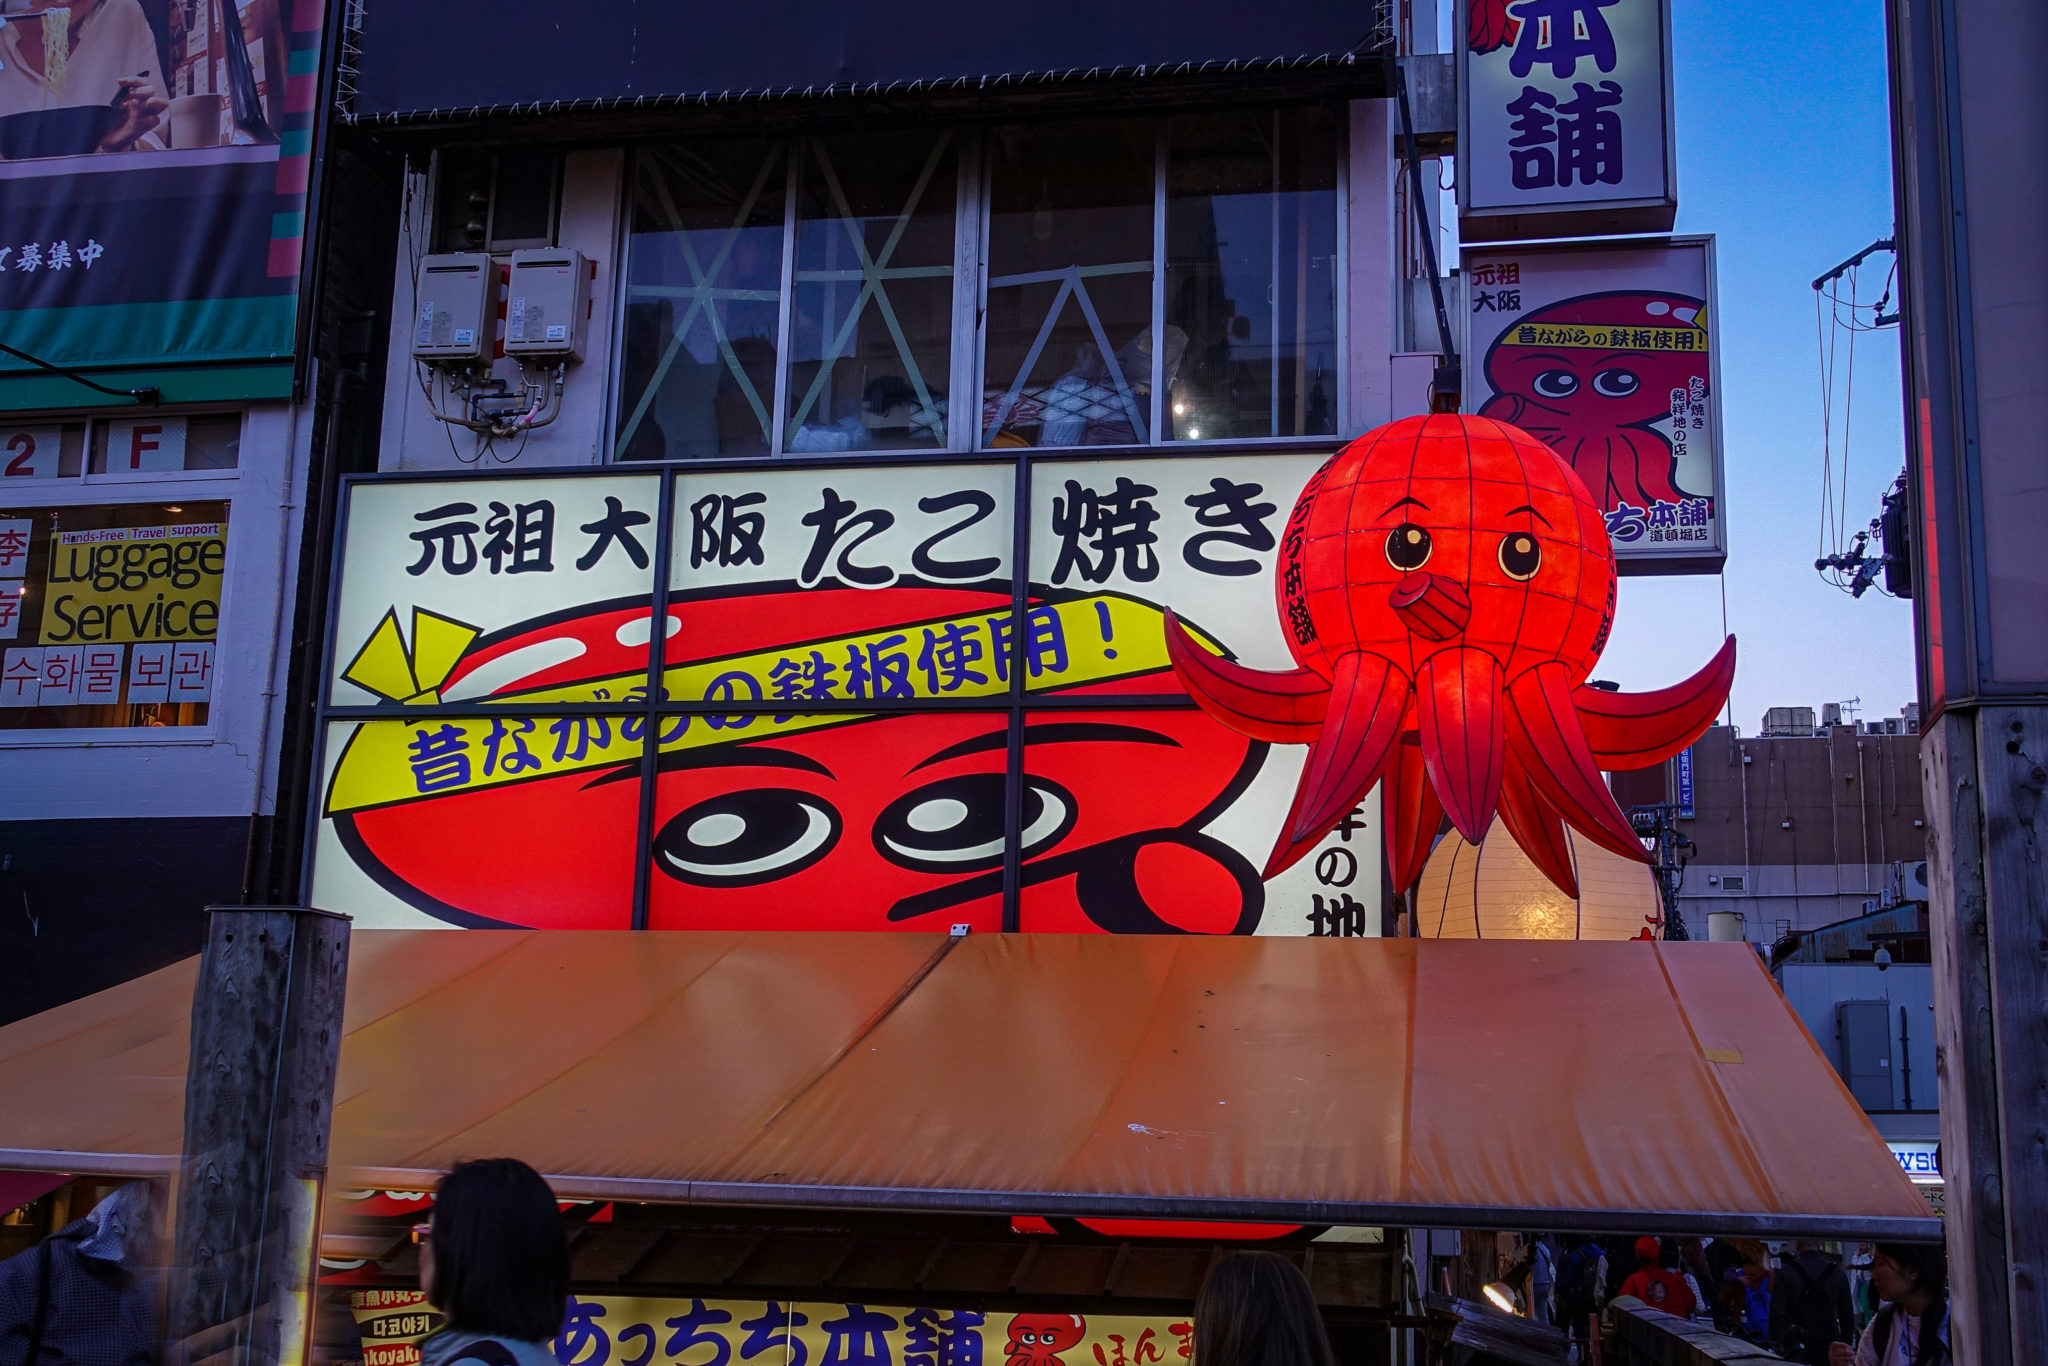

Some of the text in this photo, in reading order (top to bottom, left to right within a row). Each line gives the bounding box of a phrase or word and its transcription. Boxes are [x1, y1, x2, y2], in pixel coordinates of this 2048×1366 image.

[1506, 0, 1624, 190] 本舗
[1472, 263, 1521, 286] 元祖
[1472, 289, 1522, 313] 大阪
[1517, 325, 1704, 350] 昔ながらの鉄板使用!
[1671, 389, 1688, 456] 発祥地の店
[1689, 375, 1705, 430] たこ焼き
[4, 425, 162, 476] 2 F
[62, 524, 219, 544] Hands-Free Travel support
[406, 477, 1278, 588] 元祖大阪たこ焼き
[1650, 528, 1708, 542] 道頓堀店
[49, 538, 226, 592] Luggage
[48, 592, 219, 641] Service
[4, 653, 211, 695] 수화물 보관
[373, 1314, 430, 1337] 다코야키
[553, 1295, 985, 1366] あっちち本舗
